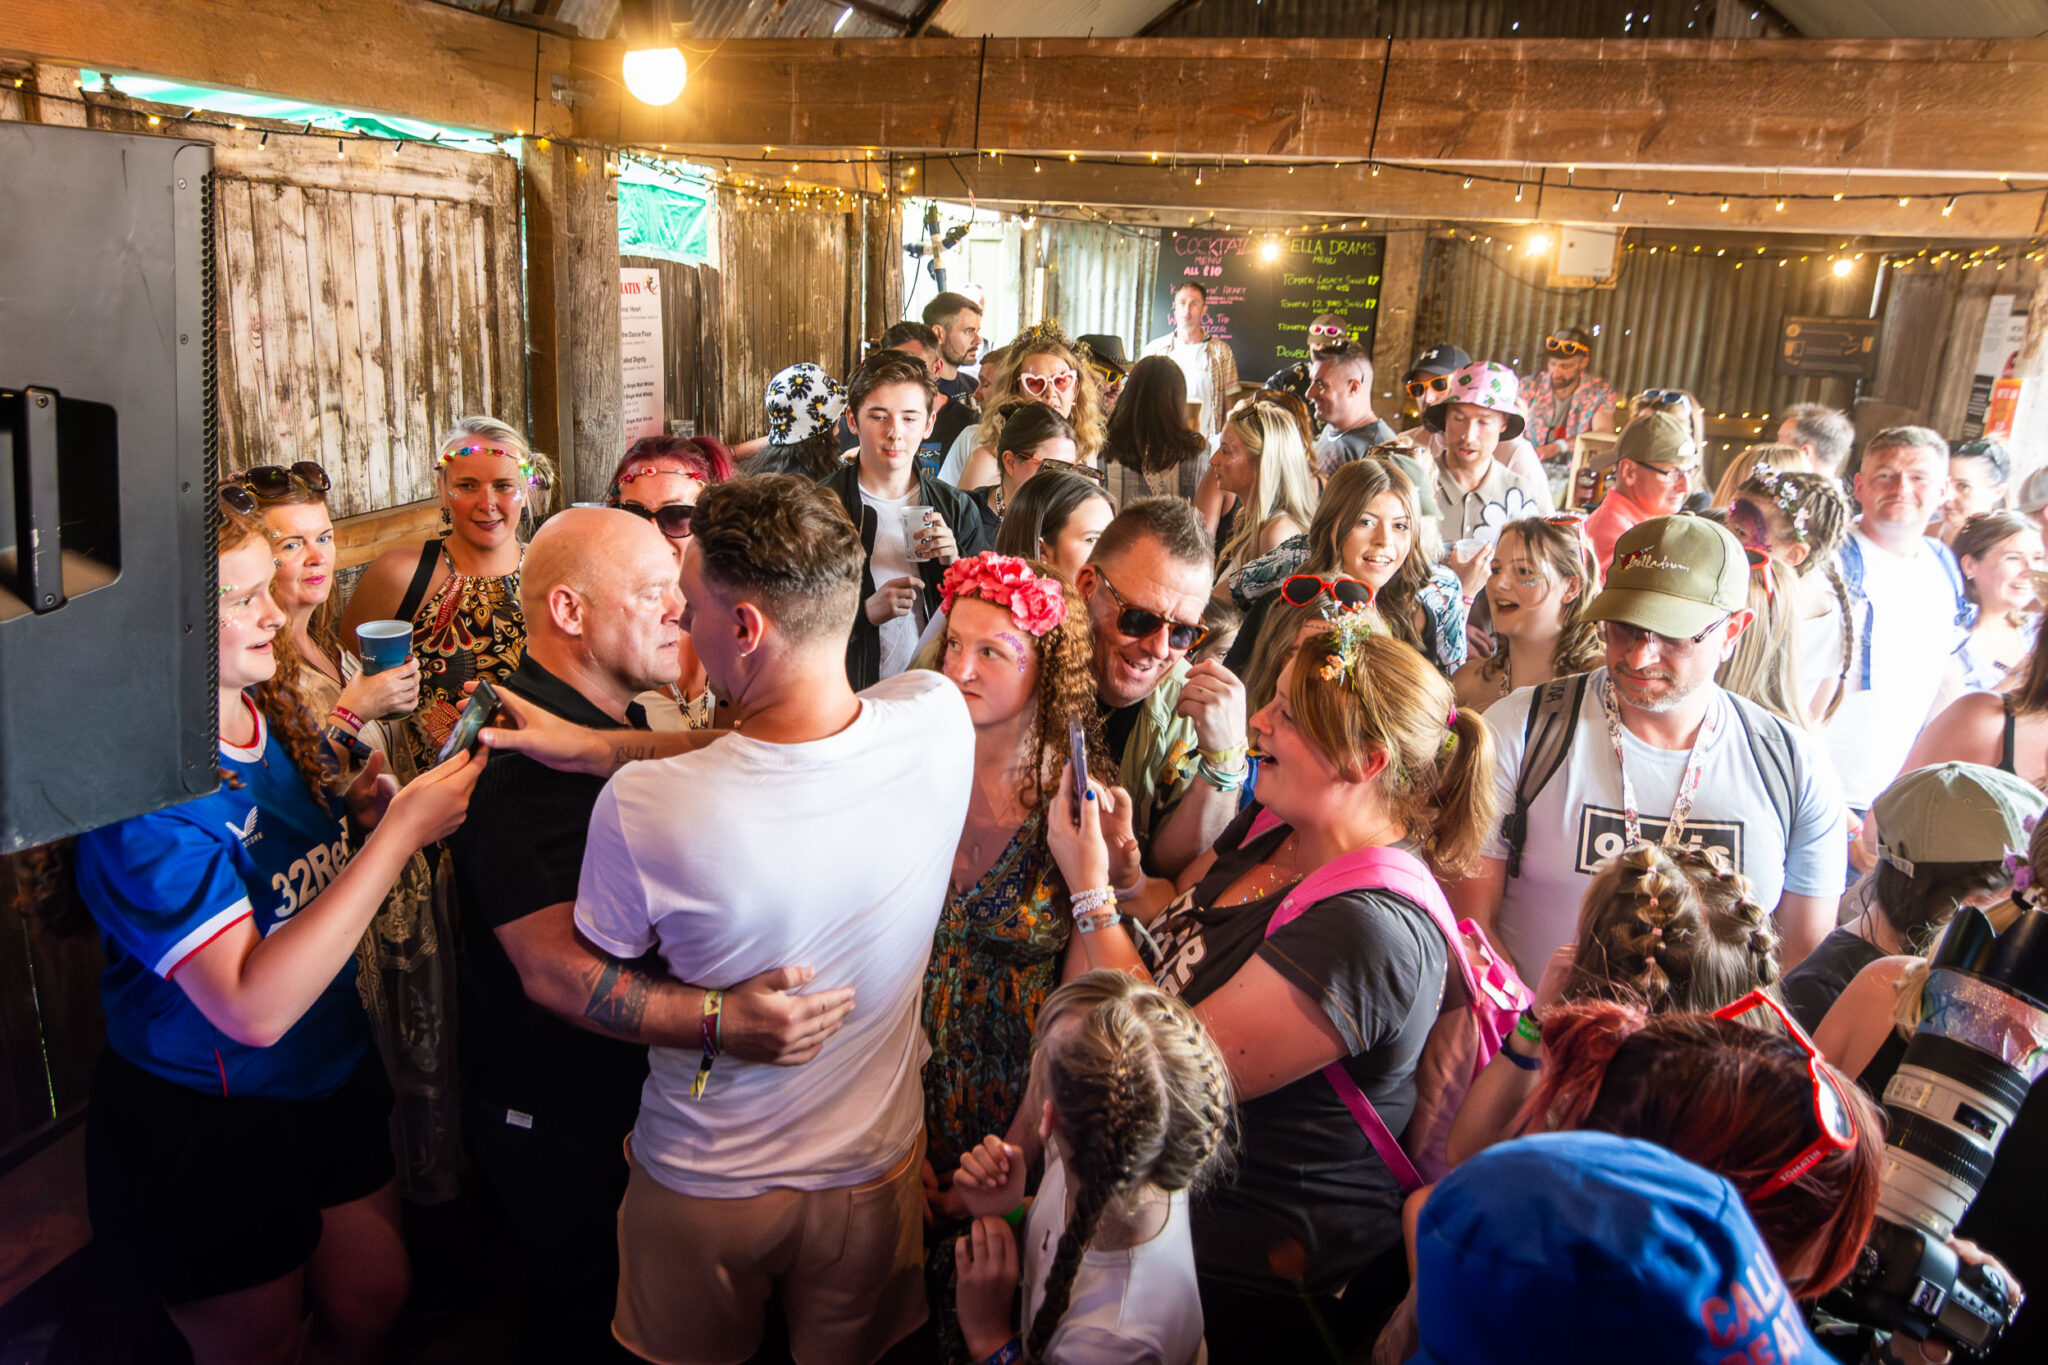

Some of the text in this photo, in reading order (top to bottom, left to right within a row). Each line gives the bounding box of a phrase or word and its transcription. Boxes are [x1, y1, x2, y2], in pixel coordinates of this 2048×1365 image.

[1329, 240, 1377, 256] DRAMS
[1194, 256, 1222, 264] MENU
[1312, 256, 1336, 265] MENU
[1183, 266, 1199, 275] ALL
[621, 281, 641, 295] ATIN
[1779, 1150, 1822, 1182] TOMATIN
